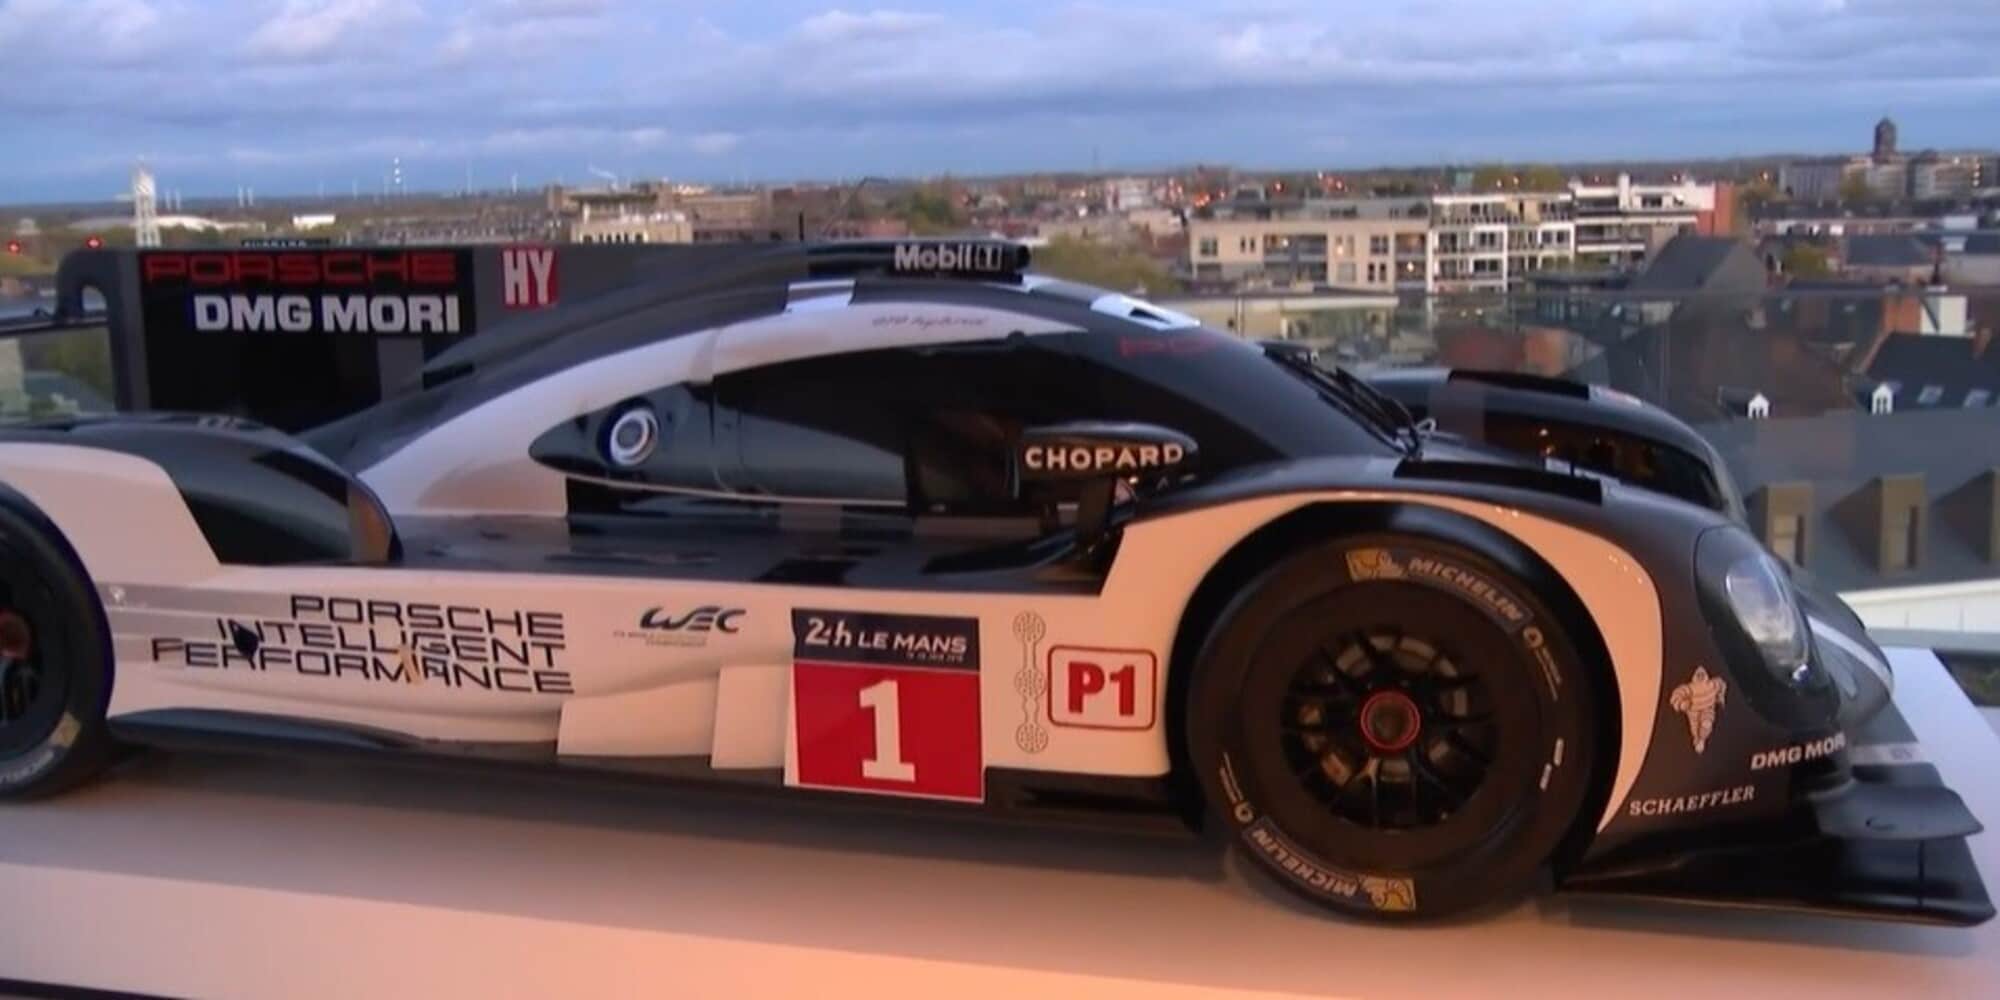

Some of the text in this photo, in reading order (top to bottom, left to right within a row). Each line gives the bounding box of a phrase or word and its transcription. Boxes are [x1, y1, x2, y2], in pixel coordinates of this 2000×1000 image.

[144, 252, 456, 283] PORSCHE
[502, 249, 555, 305] HY
[894, 243, 972, 271] Mobil
[193, 294, 461, 333] DMG MORI
[1024, 442, 1184, 471] CHOPARD
[1408, 556, 1524, 622] MICHELIN
[290, 594, 565, 640] PORSCHE
[640, 605, 747, 634] WEC
[217, 617, 566, 668] INTELLIGENT
[857, 631, 889, 650] LE
[893, 633, 968, 655] MANS
[151, 637, 575, 695] PERFORMANCE
[1067, 660, 1136, 718] P1
[858, 679, 917, 783] 1
[1750, 730, 1847, 771] DMG MOR
[1629, 784, 1756, 817] SCHAEFFLER
[1252, 828, 1359, 898] MICHELIN
